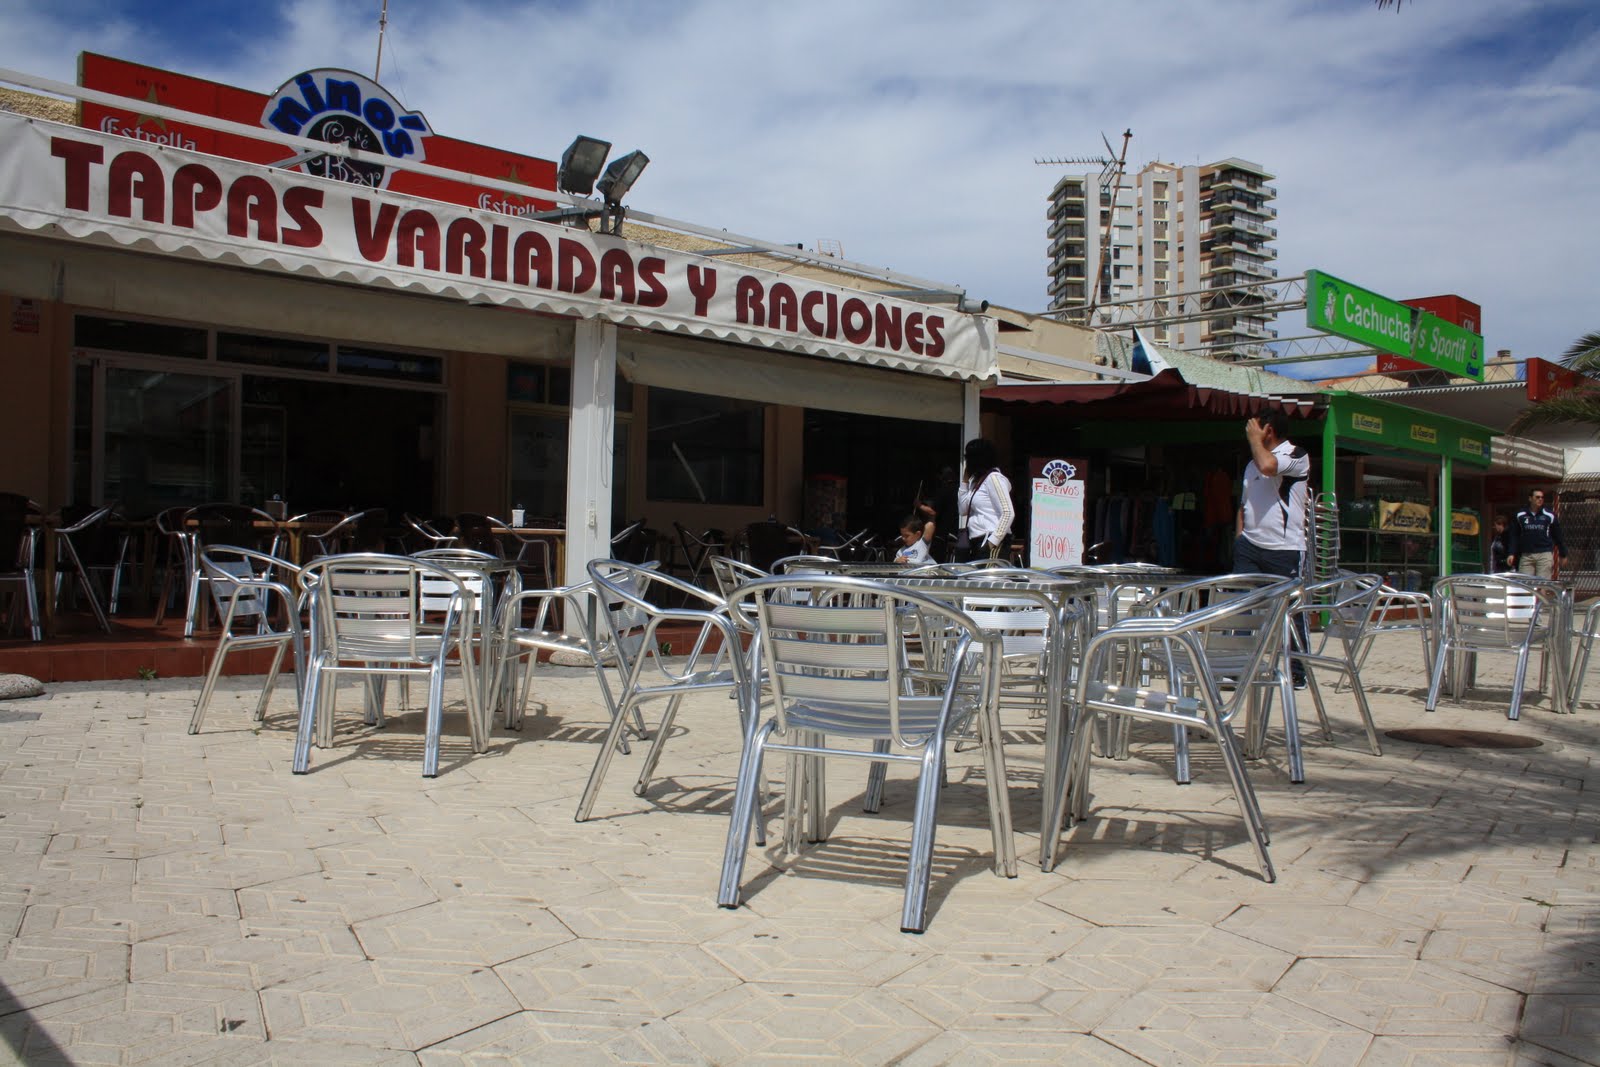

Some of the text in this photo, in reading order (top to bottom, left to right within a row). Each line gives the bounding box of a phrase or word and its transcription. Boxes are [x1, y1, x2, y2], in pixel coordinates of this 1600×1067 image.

[100, 116, 197, 151] Estrella
[478, 192, 544, 216] Estrell
[50, 136, 946, 358] TAPAS VARIADAS Y RACIONES
[1430, 326, 1467, 363] Sportif
[1034, 482, 1080, 497] FESTIVOS
